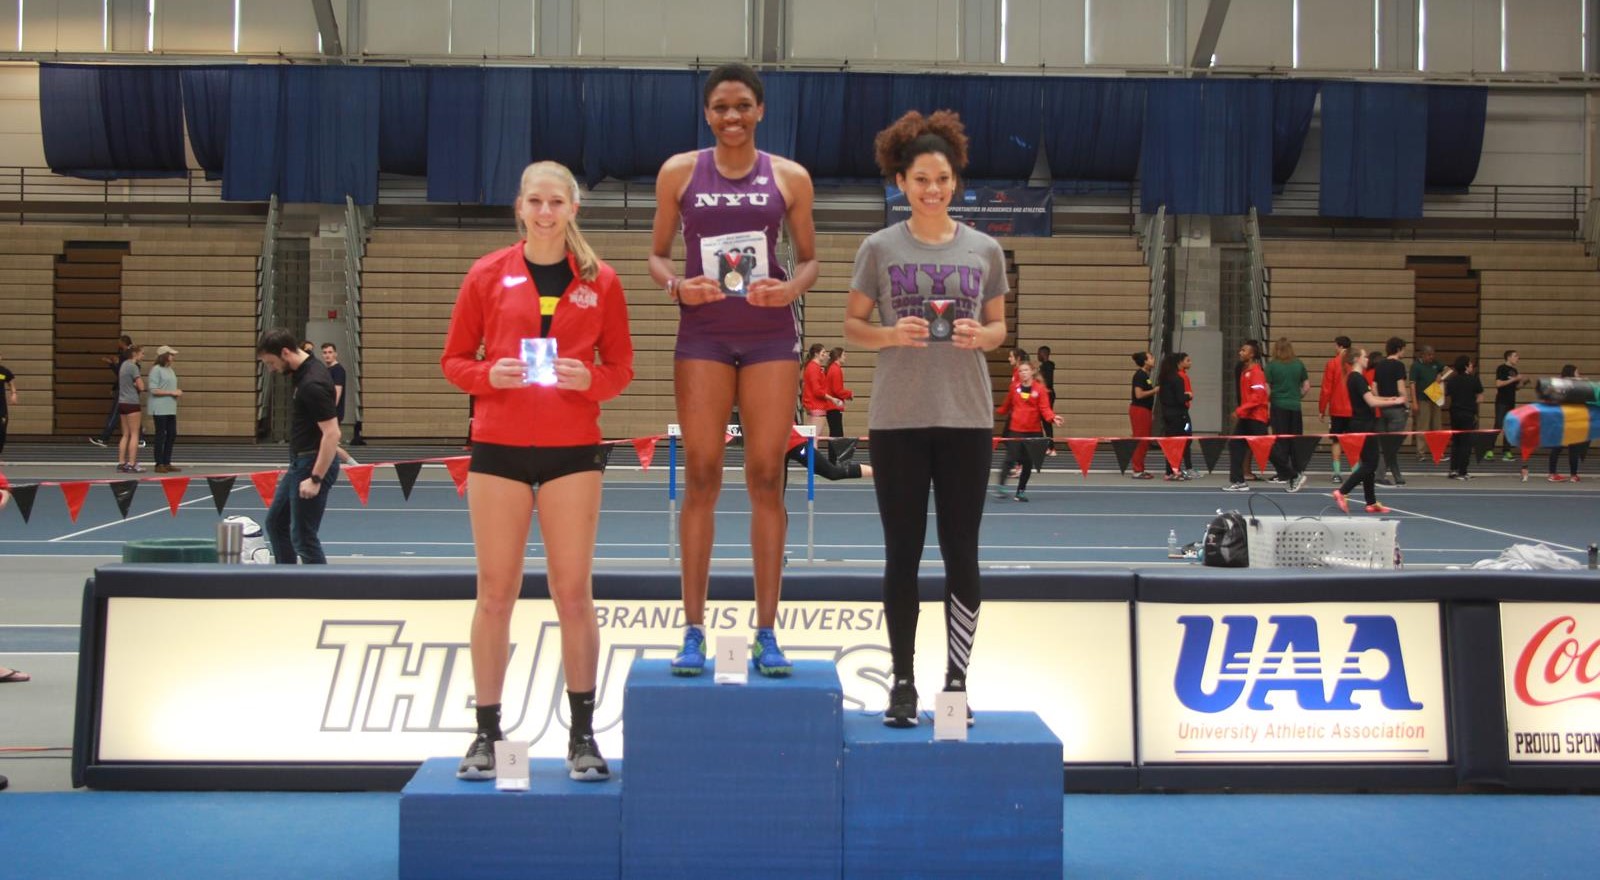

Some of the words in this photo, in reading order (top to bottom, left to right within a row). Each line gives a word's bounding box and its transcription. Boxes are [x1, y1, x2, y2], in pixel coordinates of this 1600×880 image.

[694, 192, 769, 207] NYU
[888, 264, 983, 299] NYU
[595, 606, 738, 629] BRANDIS
[728, 650, 735, 660] 1
[1174, 615, 1424, 713] UAA
[946, 706, 954, 717] 2
[1178, 722, 1258, 743] University
[1264, 722, 1325, 739] Athletic
[1331, 722, 1425, 739] Association
[1515, 732, 1561, 754] PROUD
[509, 753, 517, 766] 3
